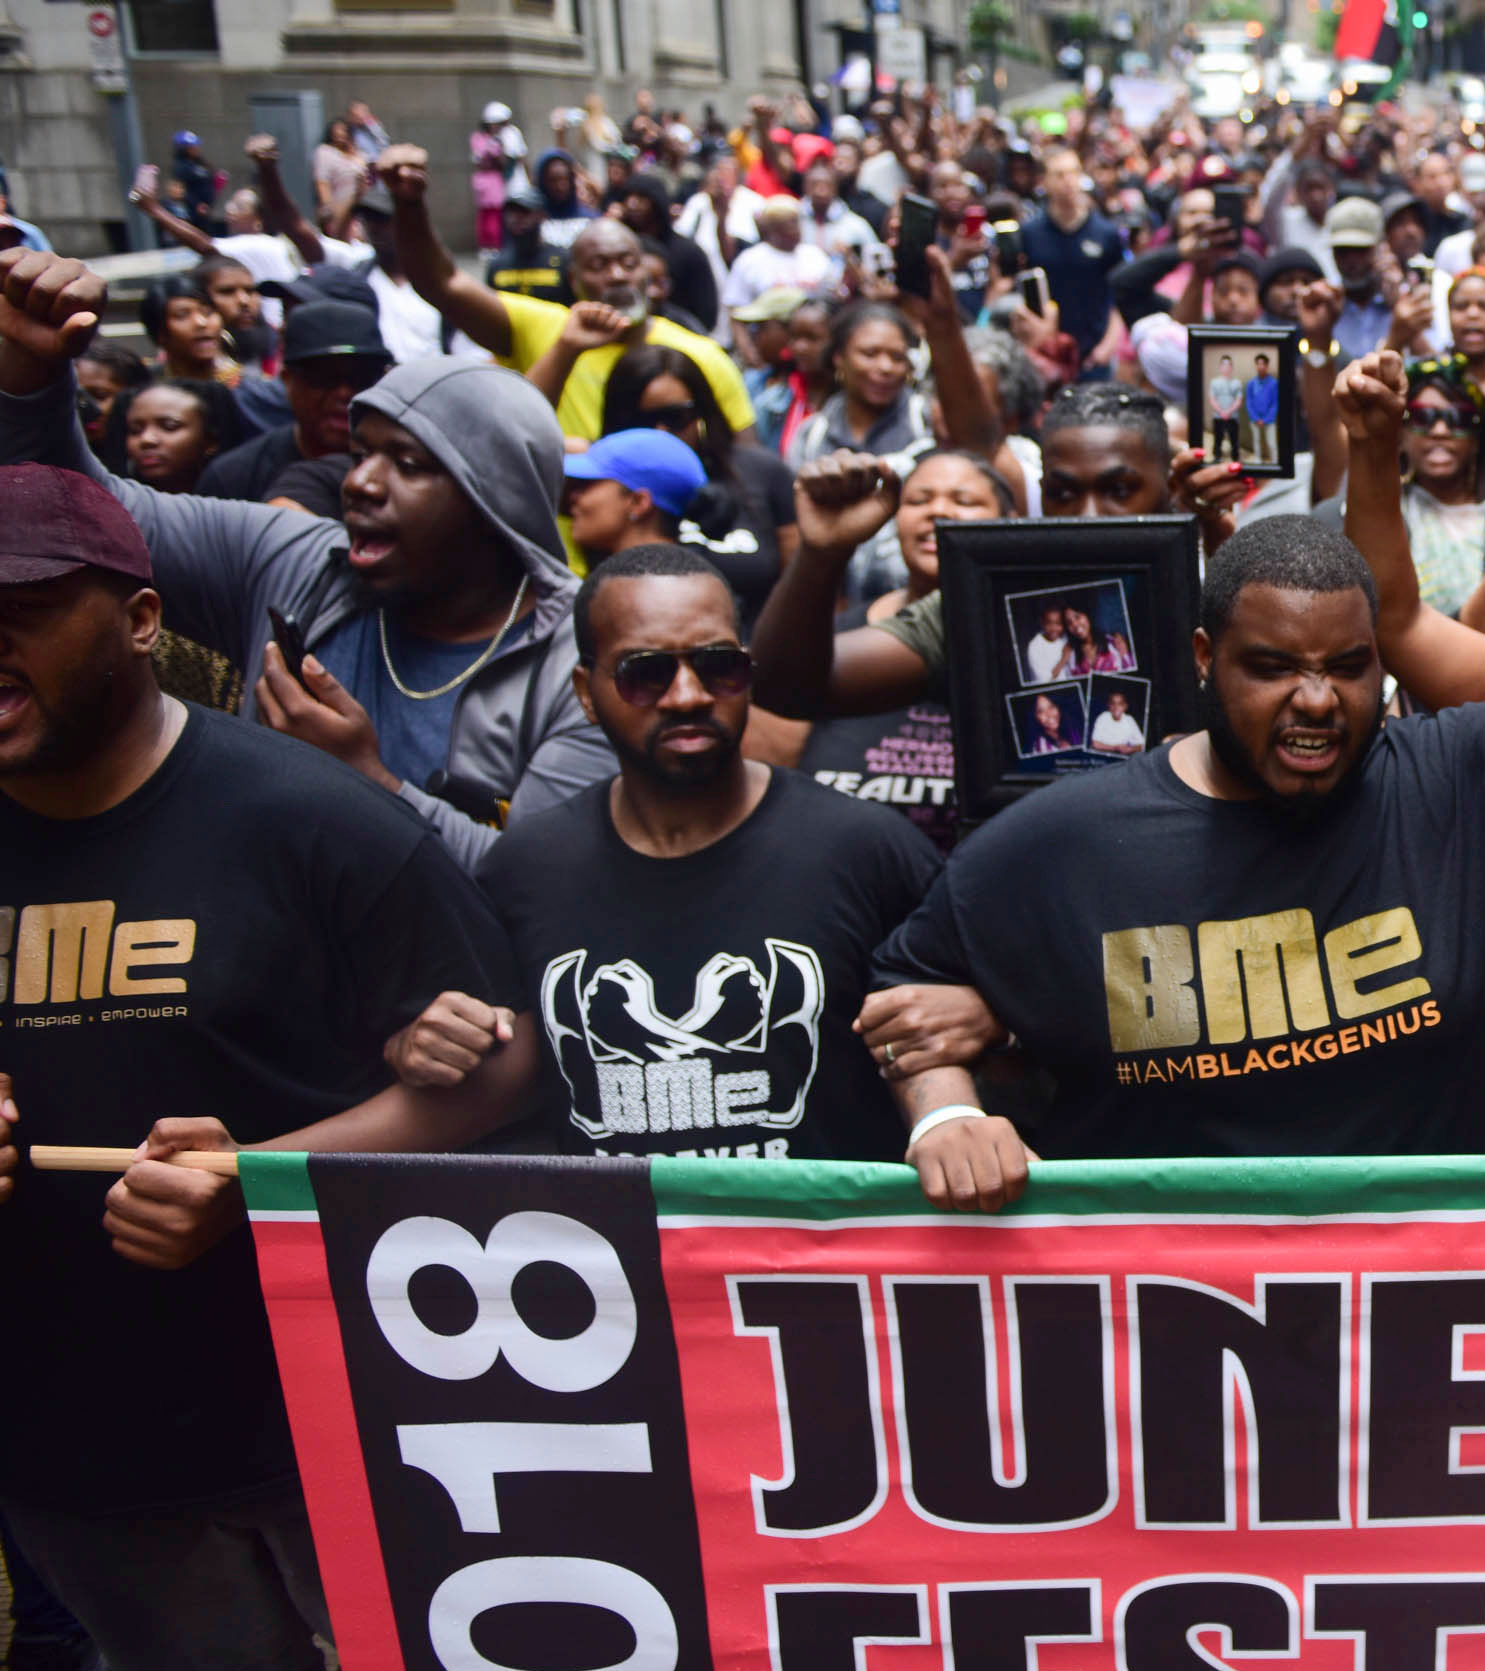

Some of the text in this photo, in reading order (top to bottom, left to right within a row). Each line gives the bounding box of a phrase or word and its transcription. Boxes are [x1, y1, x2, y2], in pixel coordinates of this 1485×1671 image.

[0, 900, 197, 1005] Me
[1102, 906, 1433, 1054] BMe
[16, 1006, 188, 1028] INSPIRE EMPOWER
[1115, 1000, 1442, 1086] #IAMBLACKGENIUS
[596, 1058, 771, 1135] BMe
